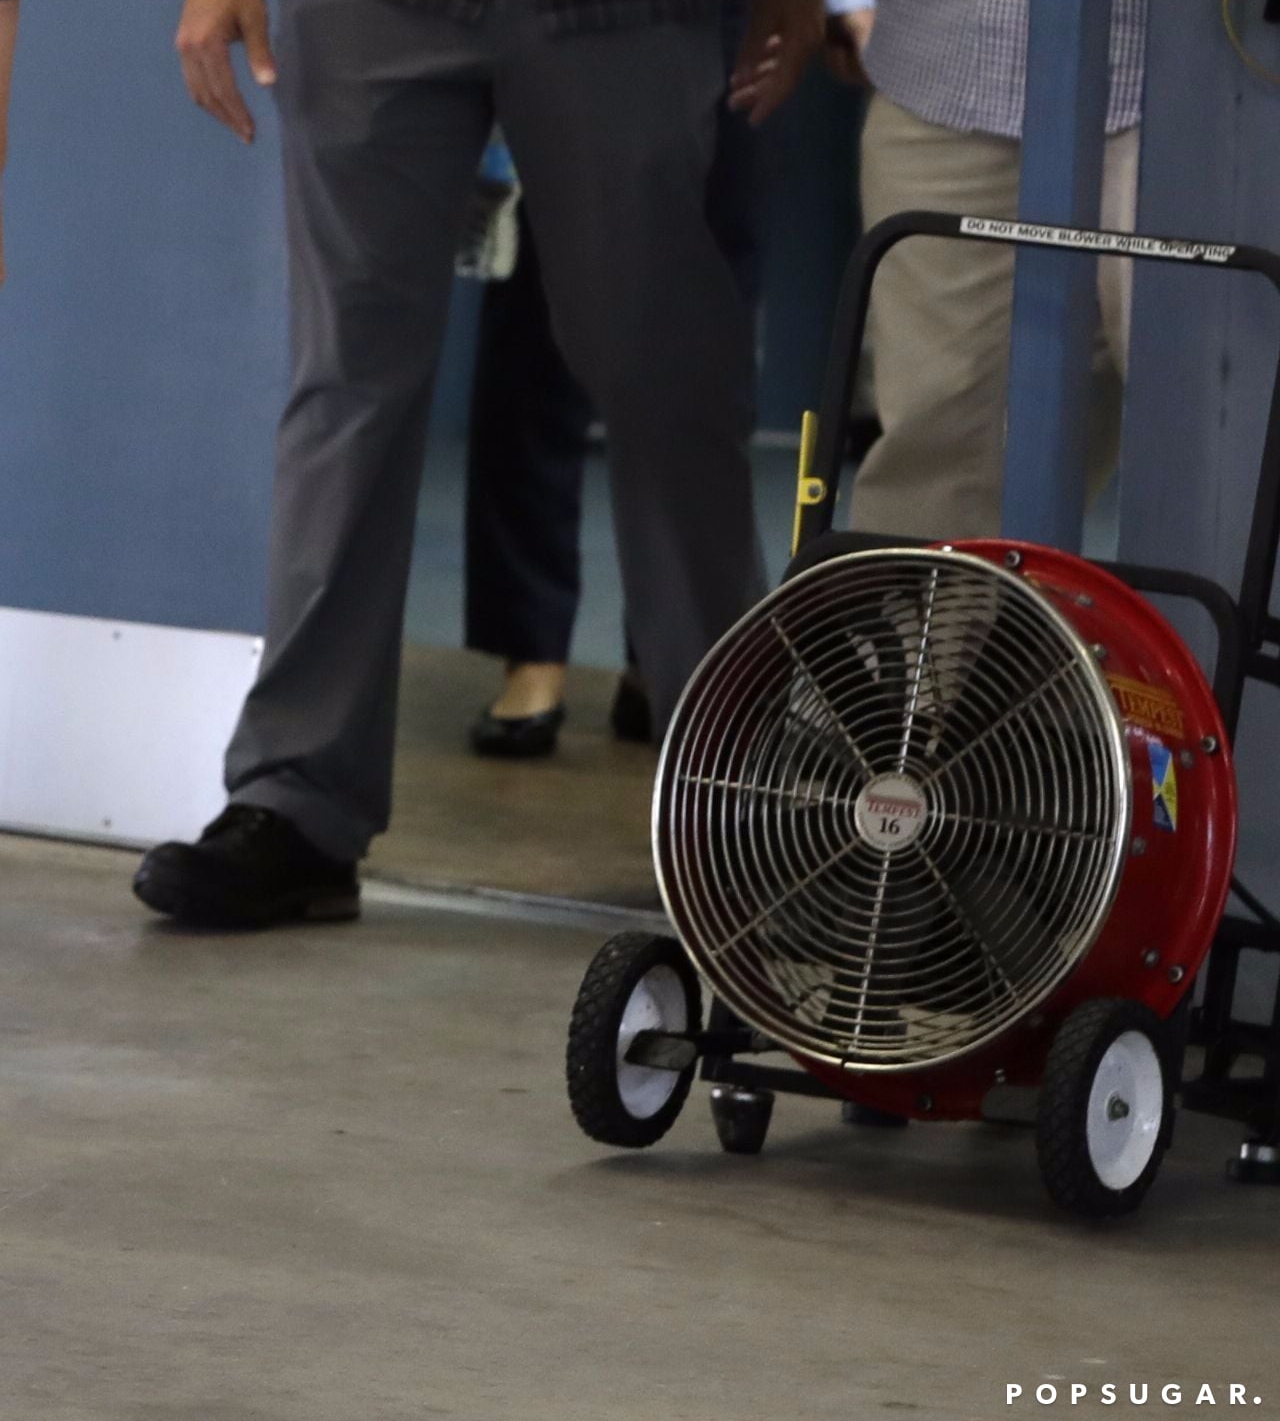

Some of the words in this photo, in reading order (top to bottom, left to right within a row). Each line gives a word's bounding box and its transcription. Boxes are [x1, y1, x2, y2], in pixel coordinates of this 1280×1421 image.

[967, 220, 985, 230] DO
[989, 221, 1013, 234] NOT
[1017, 226, 1054, 239] MOVE
[1058, 230, 1111, 244] BLOWER
[1116, 236, 1152, 250] WHILE
[880, 817, 900, 835] 16
